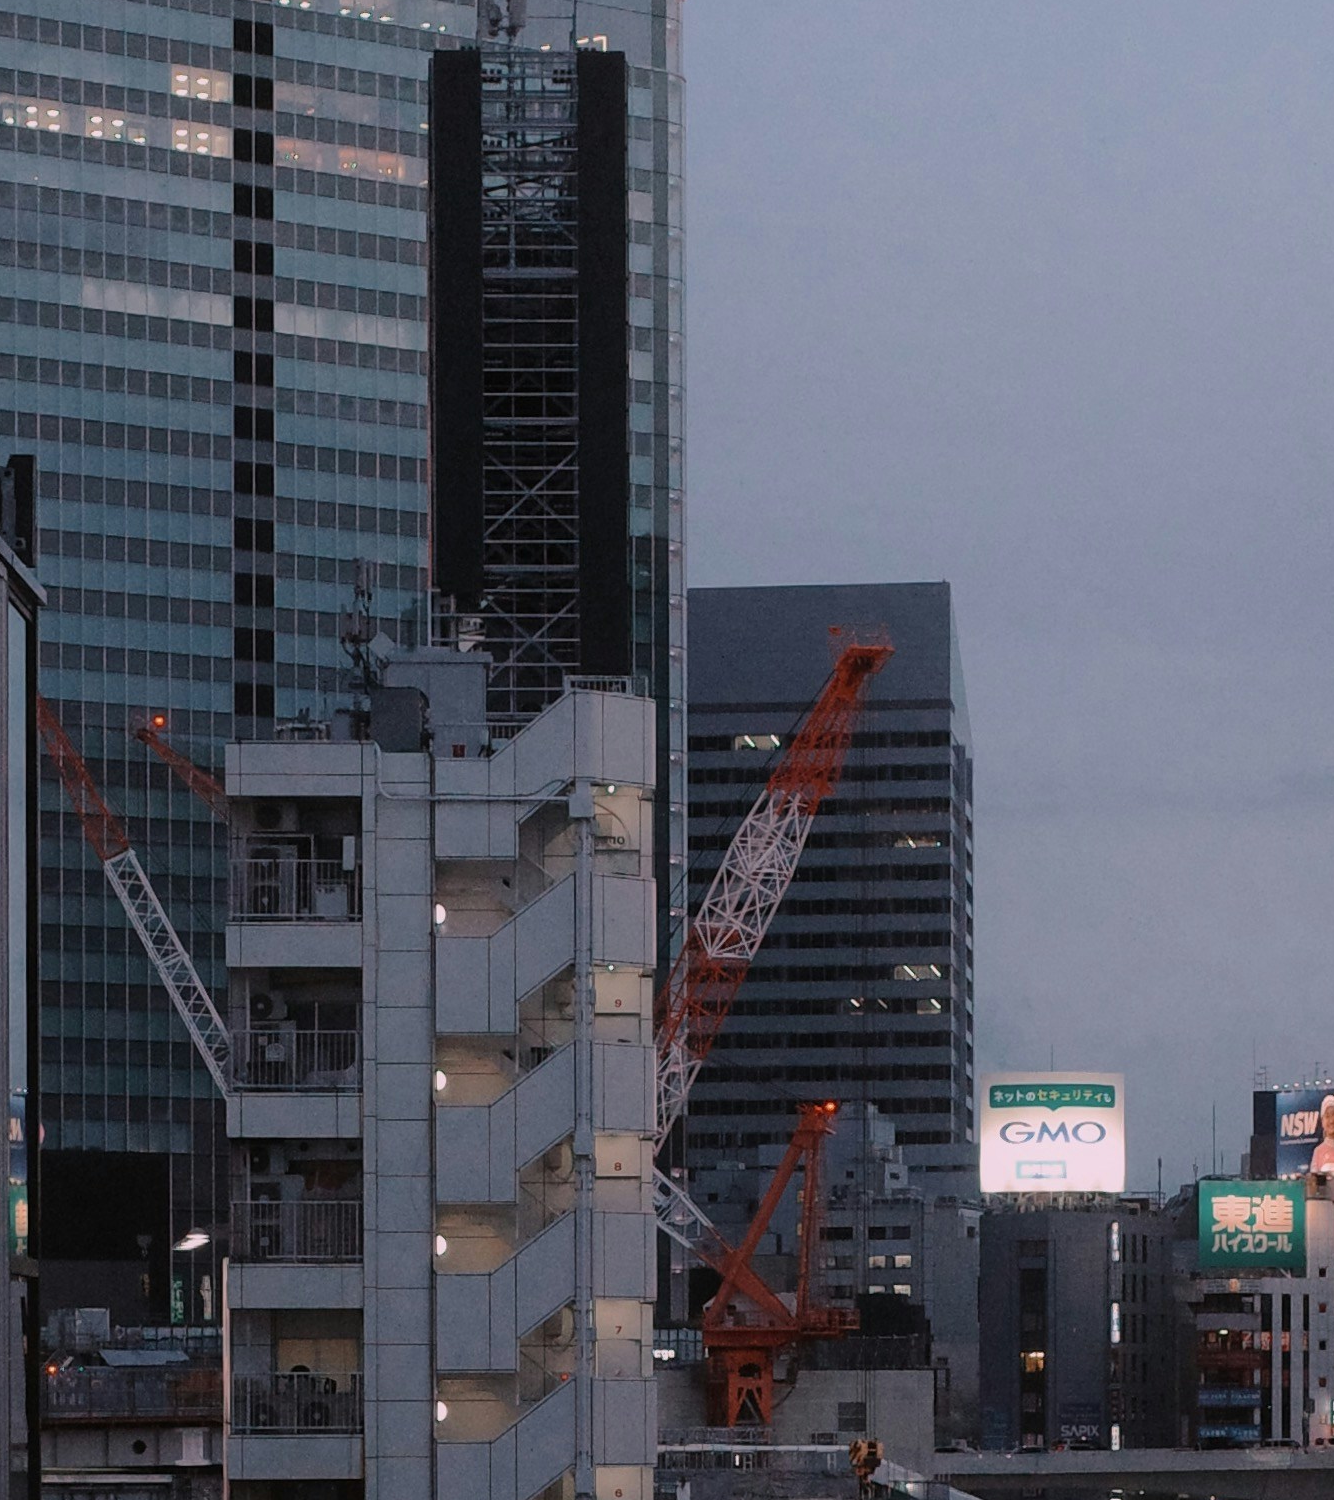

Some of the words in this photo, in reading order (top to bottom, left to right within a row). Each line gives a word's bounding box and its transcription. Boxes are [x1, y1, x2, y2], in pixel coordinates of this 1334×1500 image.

[614, 999, 622, 1008] 9
[993, 1089, 1112, 1103] ネットのセキュリティも
[1280, 1110, 1320, 1138] NSW
[999, 1121, 1107, 1145] GMO
[614, 1161, 622, 1172] 8
[1211, 1194, 1294, 1233] 東進
[1211, 1234, 1293, 1254] ハイスクール
[615, 1326, 622, 1335] 7
[1061, 1425, 1099, 1437] SAPIX
[615, 1488, 622, 1498] 6
